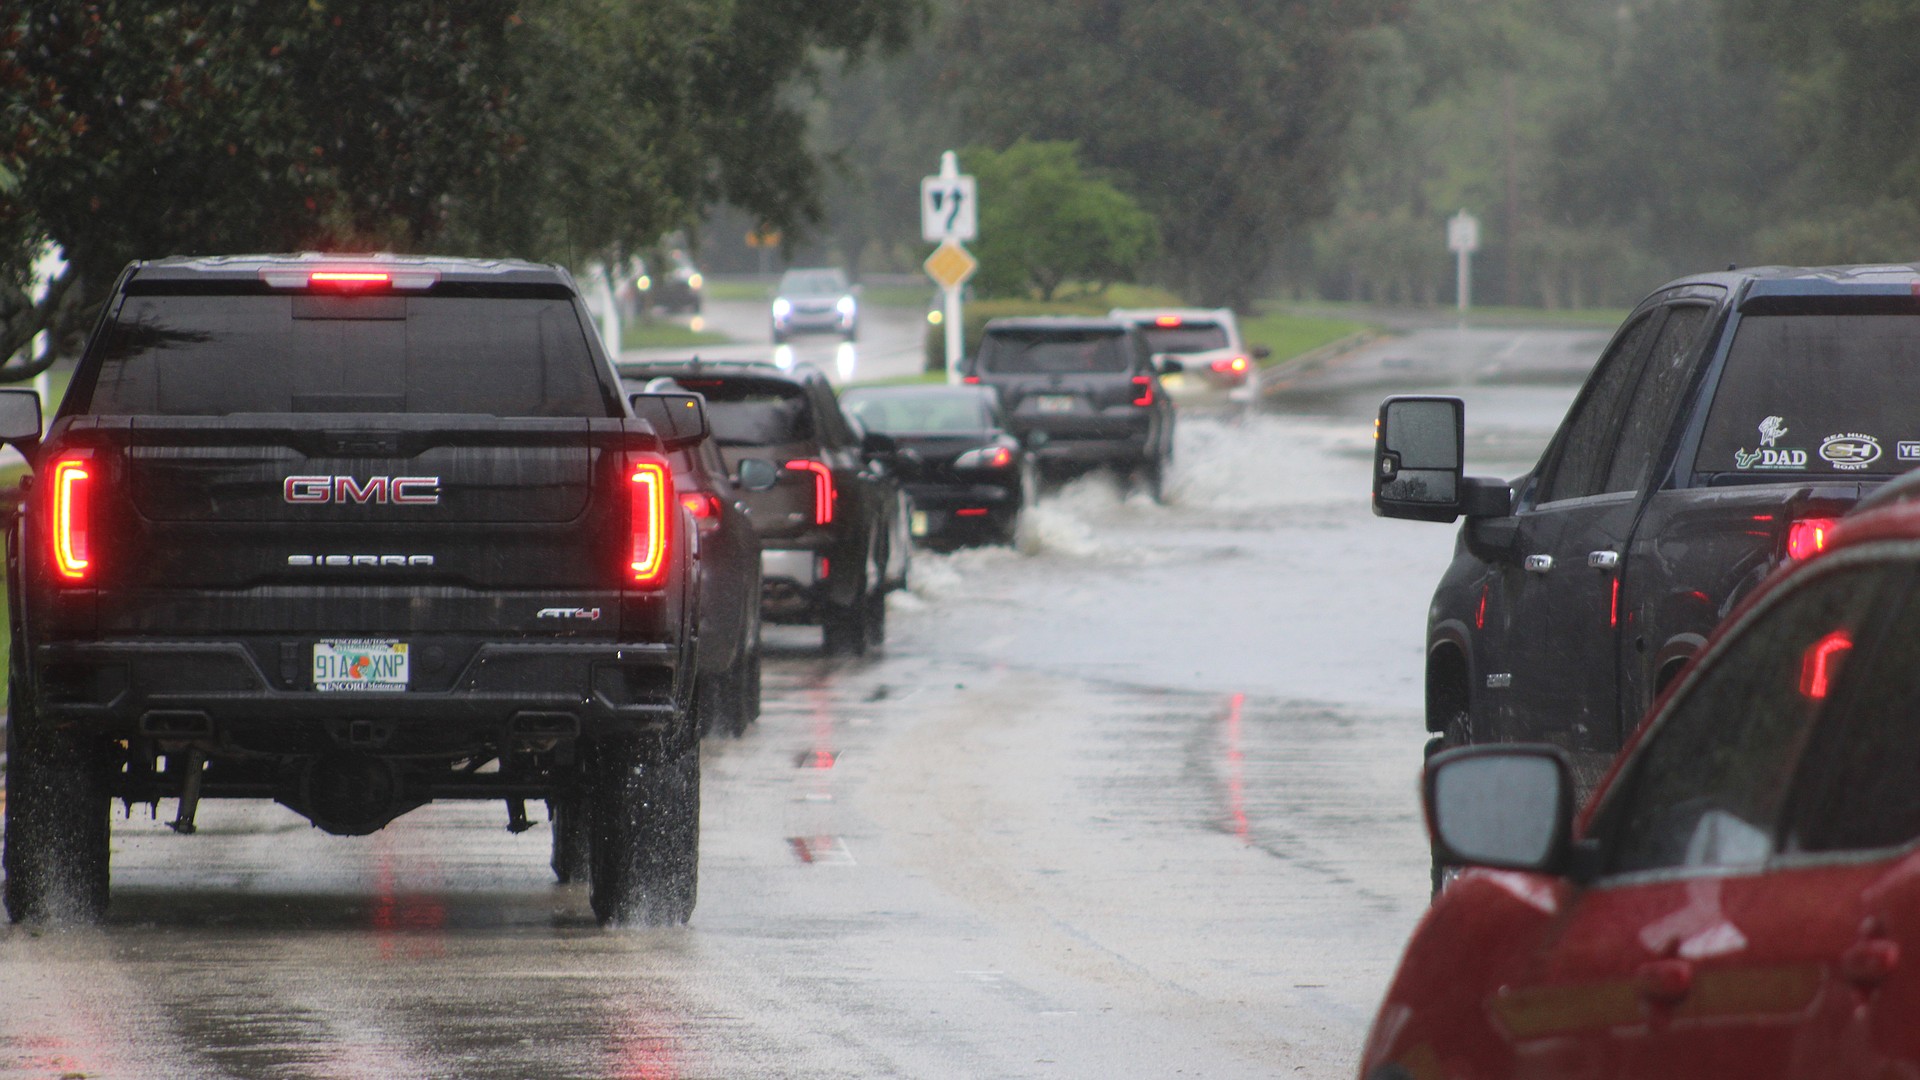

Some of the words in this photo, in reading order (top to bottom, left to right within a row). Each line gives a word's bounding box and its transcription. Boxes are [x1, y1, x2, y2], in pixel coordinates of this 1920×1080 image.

[1823, 433, 1844, 442] SEA
[1847, 433, 1878, 442] HUNT
[1762, 450, 1807, 465] DAD
[283, 475, 439, 504] GMC
[287, 555, 434, 566] SIERRA
[536, 608, 600, 620] AT4
[316, 655, 349, 678] 91A
[372, 655, 404, 678] XNP
[325, 682, 367, 692] ENCORE
